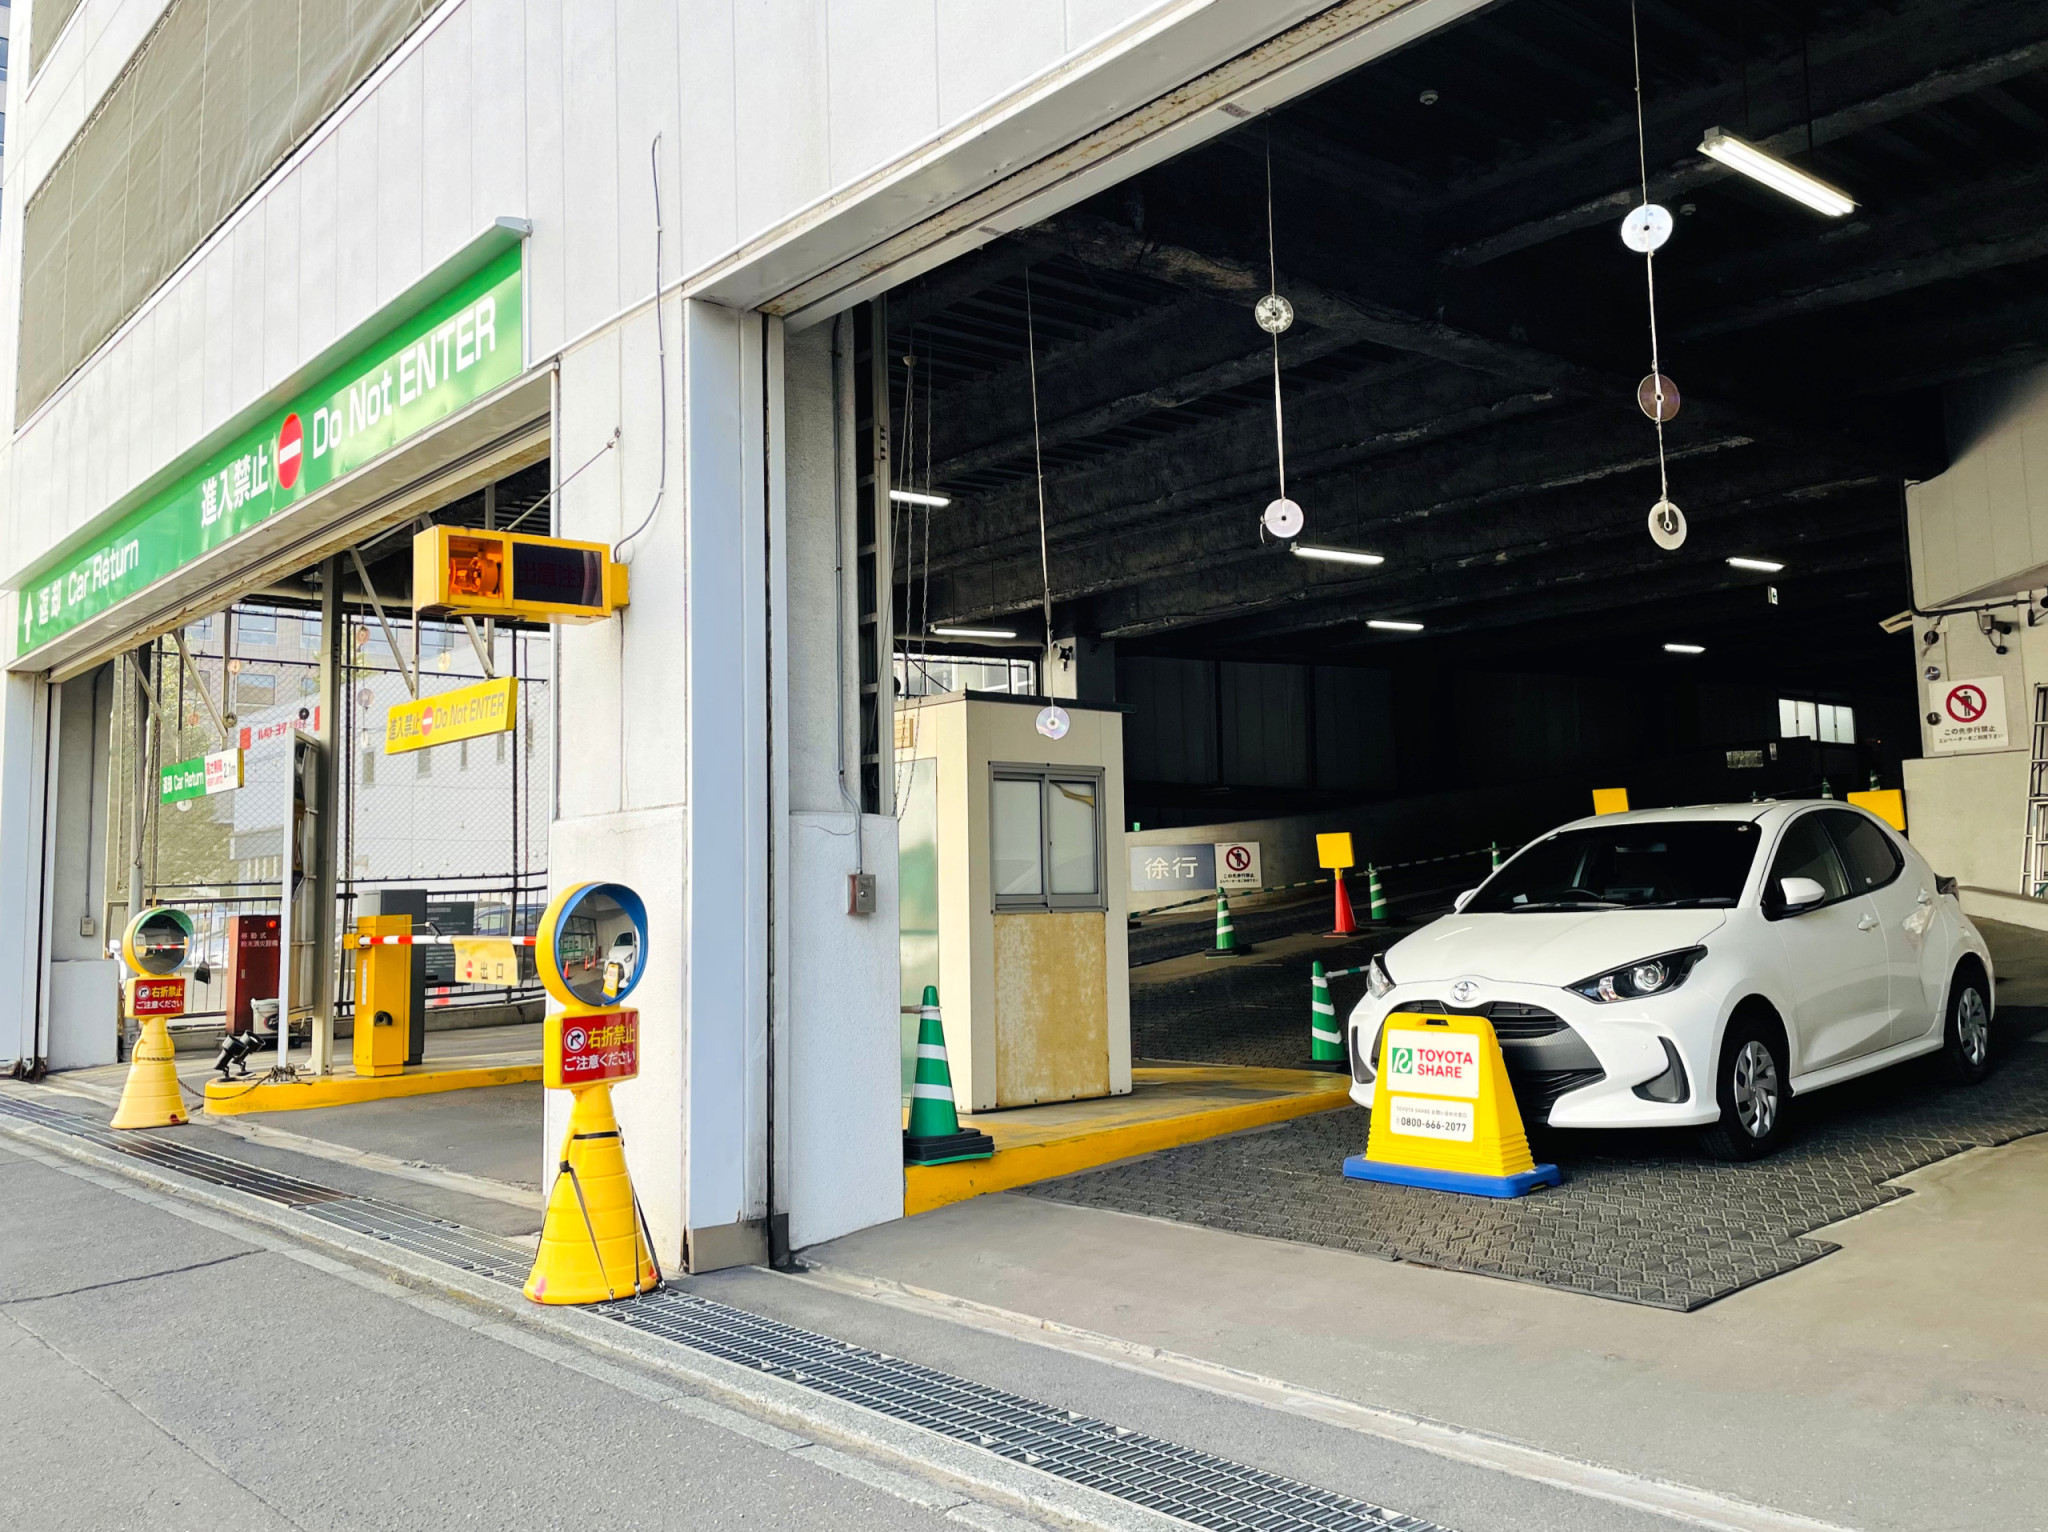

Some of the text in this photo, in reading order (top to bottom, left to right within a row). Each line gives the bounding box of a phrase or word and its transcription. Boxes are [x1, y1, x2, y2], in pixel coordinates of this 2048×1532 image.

[201, 296, 495, 529] 進入禁止 Do Not ENTER
[39, 538, 138, 627] 返却 Car Return
[389, 692, 505, 741] 進入禁止 Do Not ENTER
[174, 774, 183, 790] Car
[184, 771, 204, 788] Return
[1144, 856, 1198, 880] 徐行
[480, 961, 504, 980] 出口
[152, 986, 182, 998] 右折禁止
[136, 1000, 182, 1009] ご注意ください
[588, 1023, 635, 1049] 右折禁止
[564, 1050, 635, 1071] ご注意ください
[1417, 1048, 1473, 1065] TOYOTA
[1417, 1063, 1462, 1079] SHARE
[1401, 1117, 1467, 1132] 0800-666-2077
